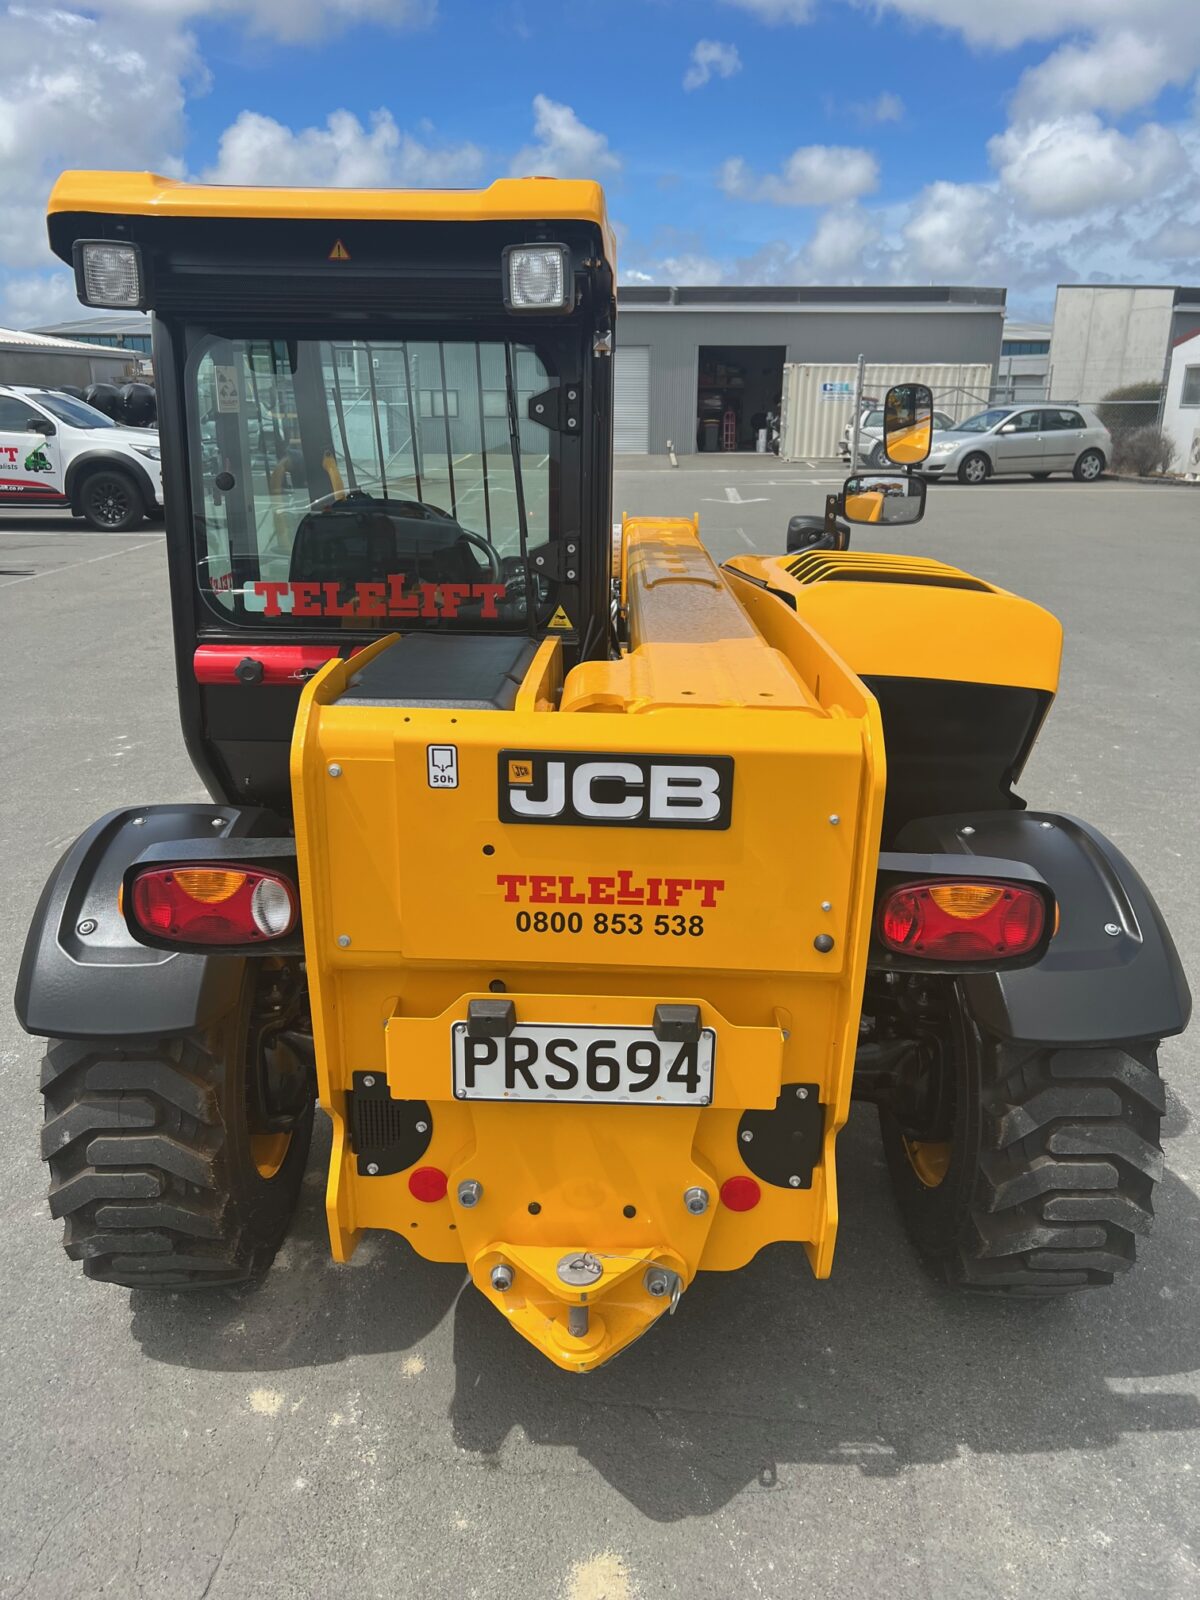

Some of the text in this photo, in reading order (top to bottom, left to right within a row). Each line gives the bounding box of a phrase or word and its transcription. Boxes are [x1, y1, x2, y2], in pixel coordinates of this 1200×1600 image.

[254, 574, 506, 618] TELELIFT
[508, 761, 722, 821] JCB
[512, 765, 530, 778] JCB
[496, 870, 725, 908] TELELIFT
[515, 911, 704, 936] 0800 853 538
[464, 1036, 701, 1094] PRS694
